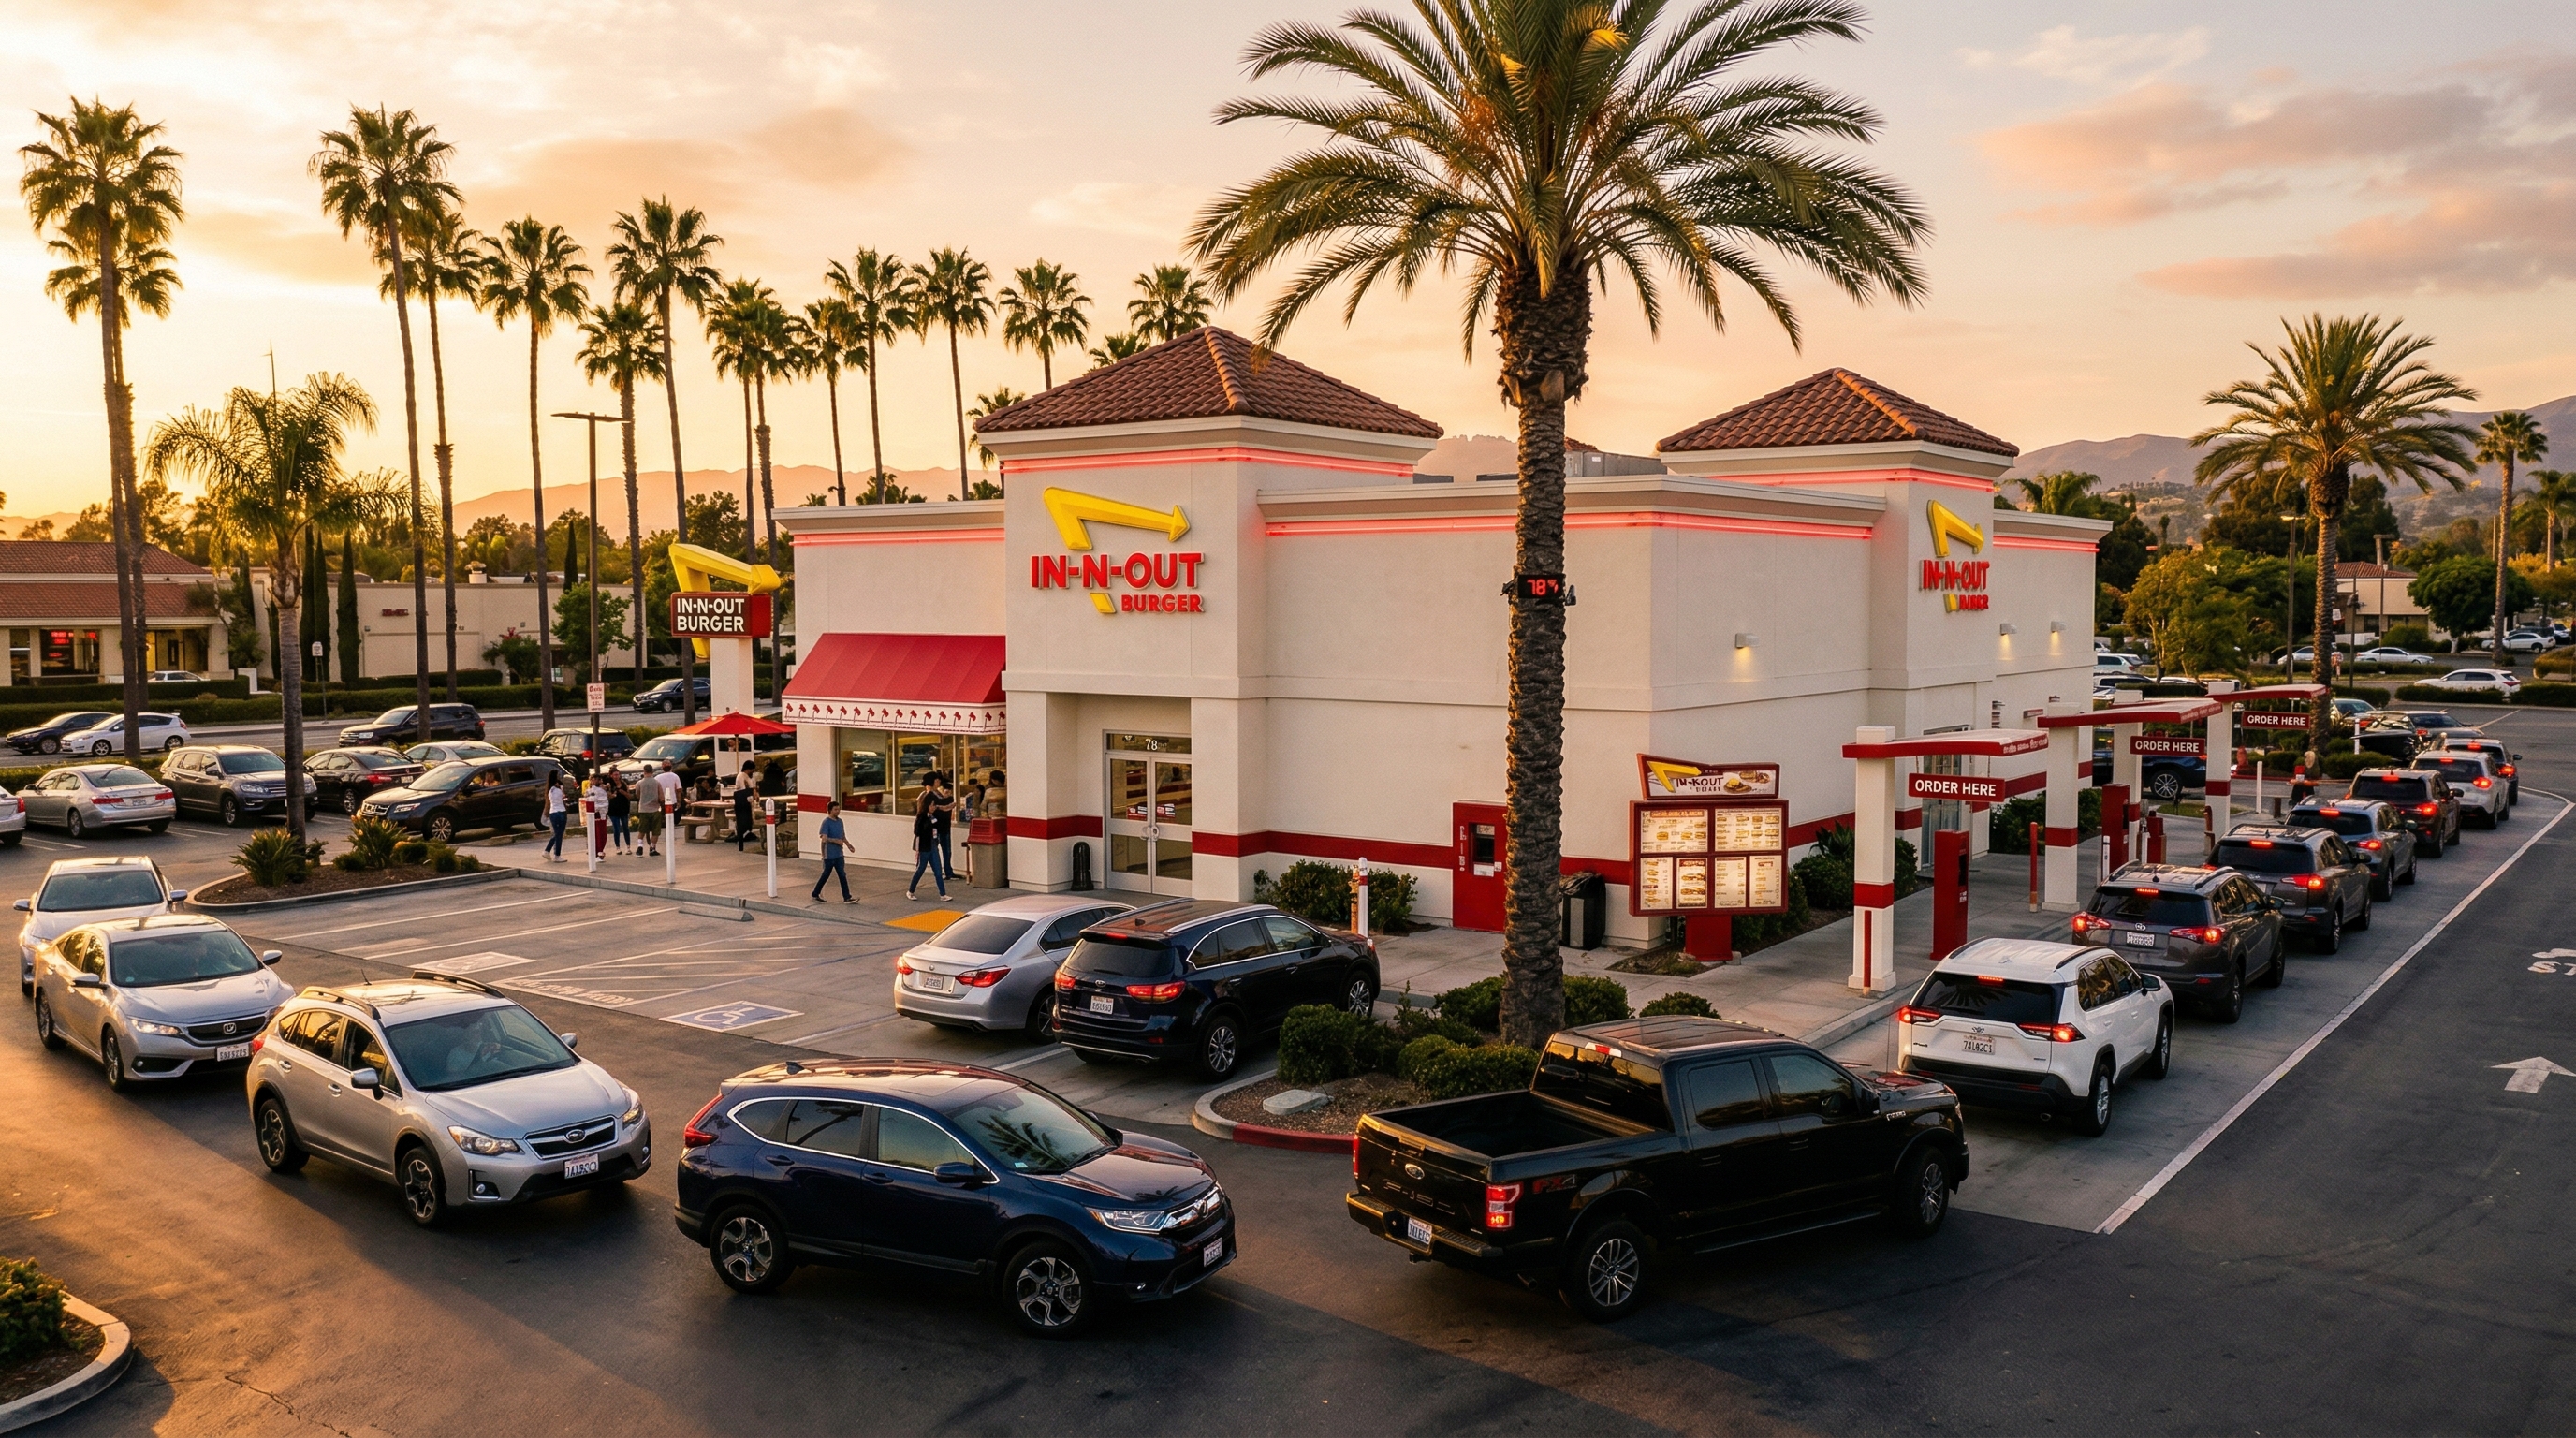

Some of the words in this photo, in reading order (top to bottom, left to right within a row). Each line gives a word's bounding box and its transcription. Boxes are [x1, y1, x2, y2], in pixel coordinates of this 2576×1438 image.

[1031, 551, 1205, 590] IN-N-OUT
[1922, 559, 1990, 591] IN-N-OUT
[677, 597, 745, 614] IN-N-OUT
[1120, 594, 1205, 614] BURGER
[677, 615, 745, 633] BURGER
[2280, 715, 2306, 726] HERE
[1145, 737, 1159, 751] 78
[2173, 741, 2200, 753] HERE
[1914, 779, 1959, 794] ORDER
[1962, 782, 1997, 797] HERE
